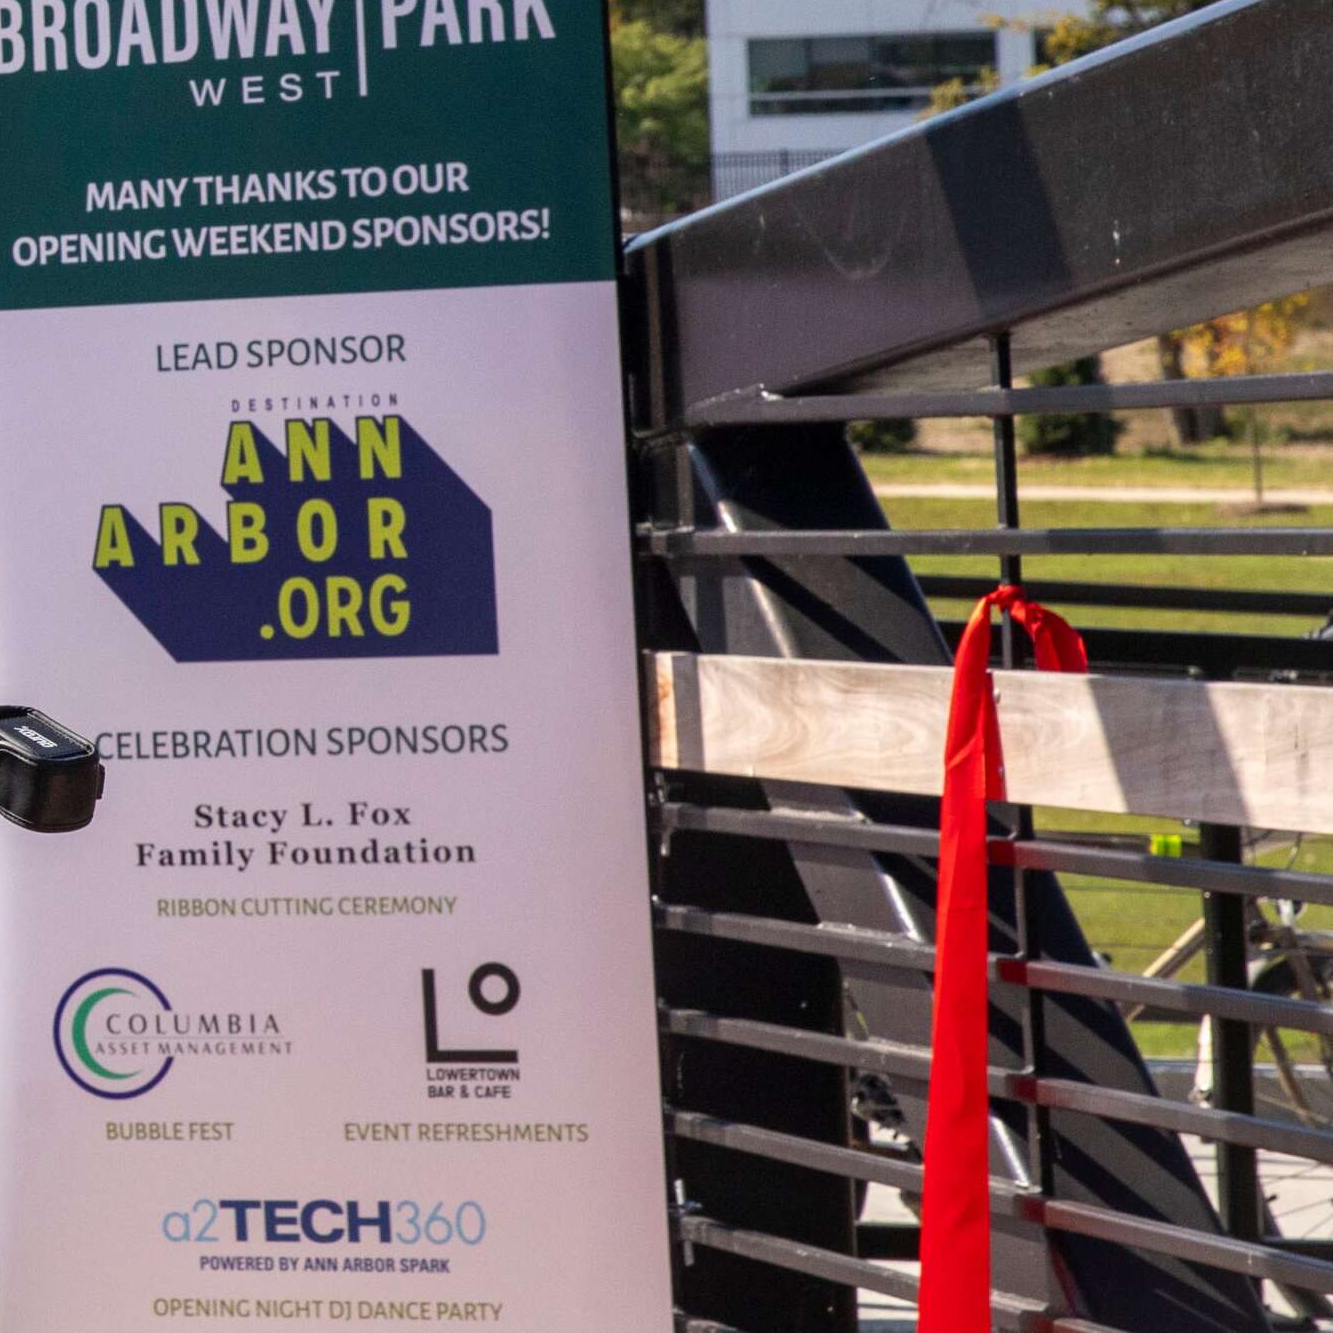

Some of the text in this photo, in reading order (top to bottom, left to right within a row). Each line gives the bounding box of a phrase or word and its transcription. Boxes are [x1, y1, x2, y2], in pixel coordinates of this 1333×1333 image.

[190, 71, 341, 107] WEST
[85, 162, 469, 212] MANY THANKS TO OUR
[12, 209, 551, 266] OPENING WEEKEND SPONSORS!
[157, 334, 407, 372] LEAD SPONSOR
[232, 393, 400, 412] DESTINATION
[223, 415, 402, 483] ANN
[94, 497, 408, 567] ARBOR
[259, 574, 410, 640] .ORG
[96, 724, 508, 760] CELEBRATION SPONSORS
[194, 801, 412, 833] Stacy L. Fox
[136, 839, 476, 871] Family Foundation
[157, 896, 457, 917] RIBBON CUTTING CEREMONY
[105, 1013, 281, 1036] COLUMBIA
[95, 1040, 293, 1056] ASSET MANAGEMENT
[427, 1068, 521, 1082] LOWERTOWN
[428, 1085, 511, 1098] BAR & CAFE
[106, 1121, 234, 1141] BUBBLE FEST
[344, 1122, 589, 1143] EVENT REFRESHMENTS
[162, 1198, 487, 1246] a2TECH360
[200, 1255, 450, 1273] POWERED BY ANN ARBOR SPARK
[154, 1298, 503, 1323] OPENING NIGHT DJ DANCE PARTY
